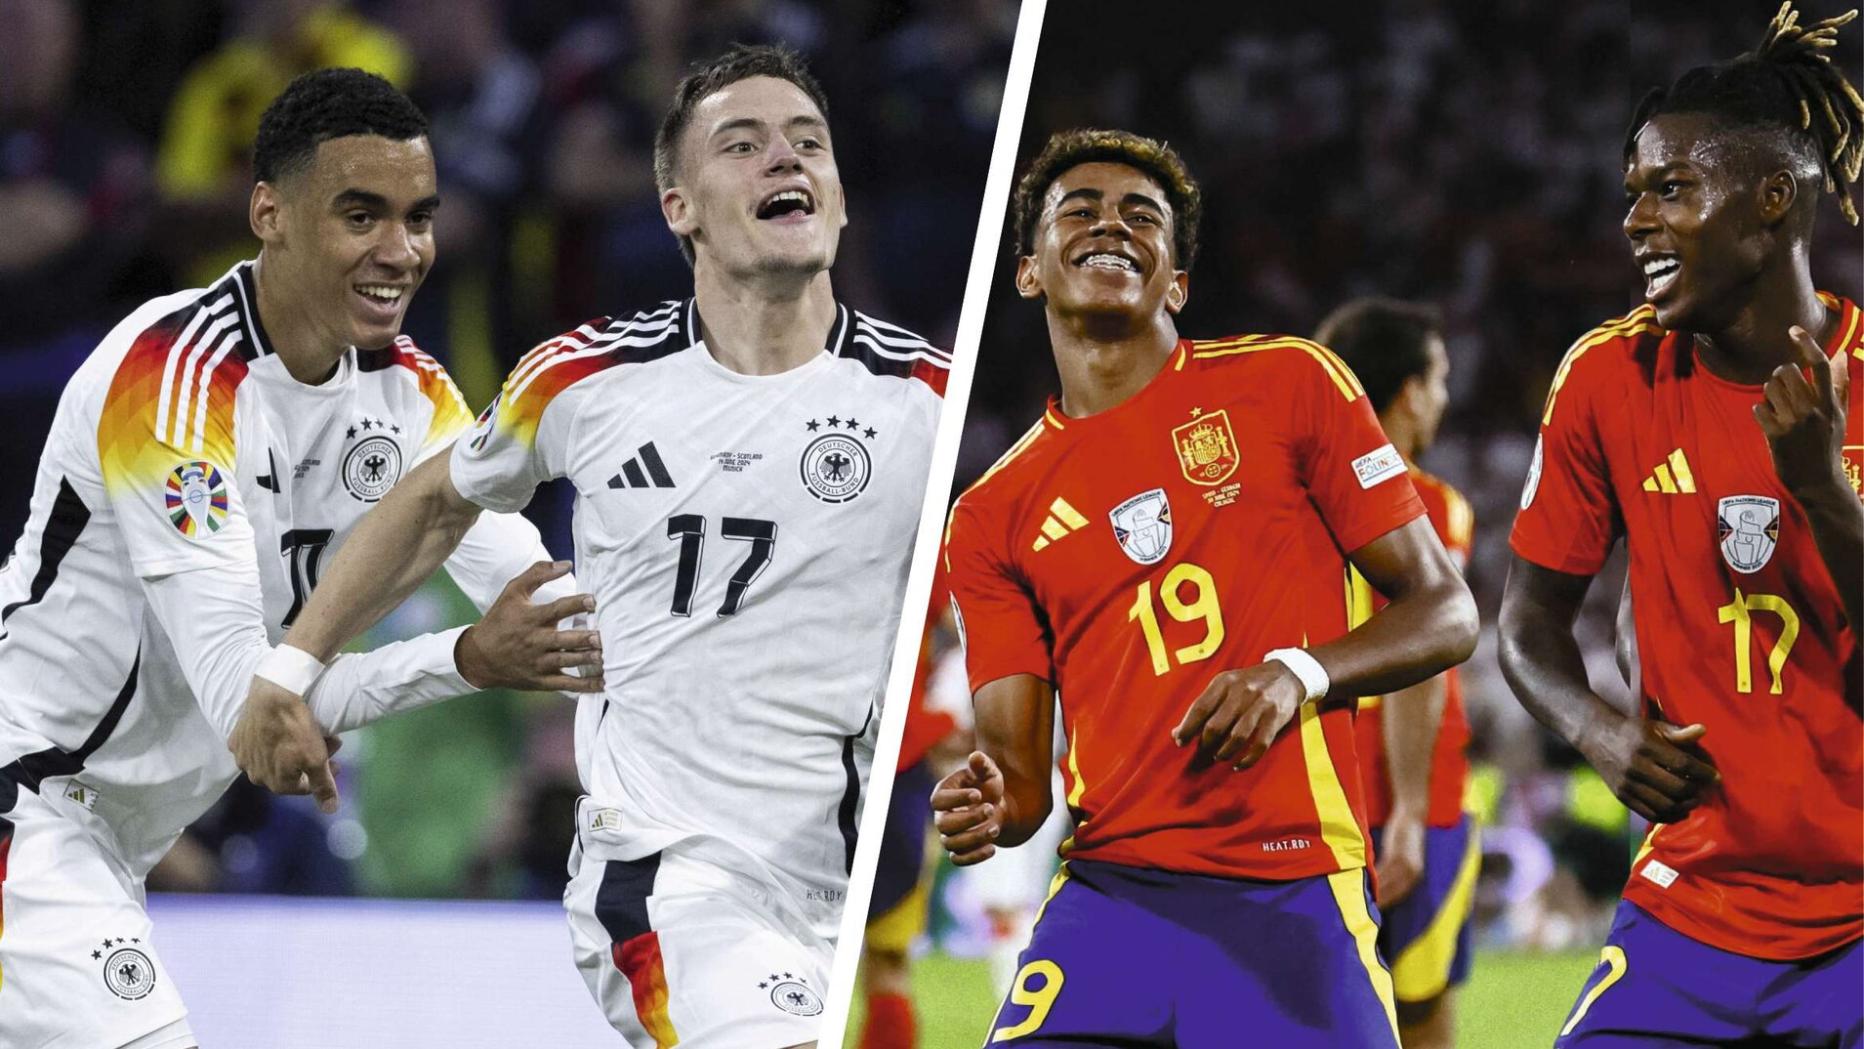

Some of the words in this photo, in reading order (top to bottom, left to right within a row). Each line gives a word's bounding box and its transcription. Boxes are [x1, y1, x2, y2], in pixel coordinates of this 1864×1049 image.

[810, 472, 860, 494] FUSSBALL-BUND
[818, 442, 858, 457] DEUTSCHER
[667, 513, 778, 618] 17
[1128, 562, 1226, 677] 19
[1718, 587, 1800, 695] 17
[1262, 839, 1311, 852] HEAT.RDY
[992, 959, 1065, 1043] 9
